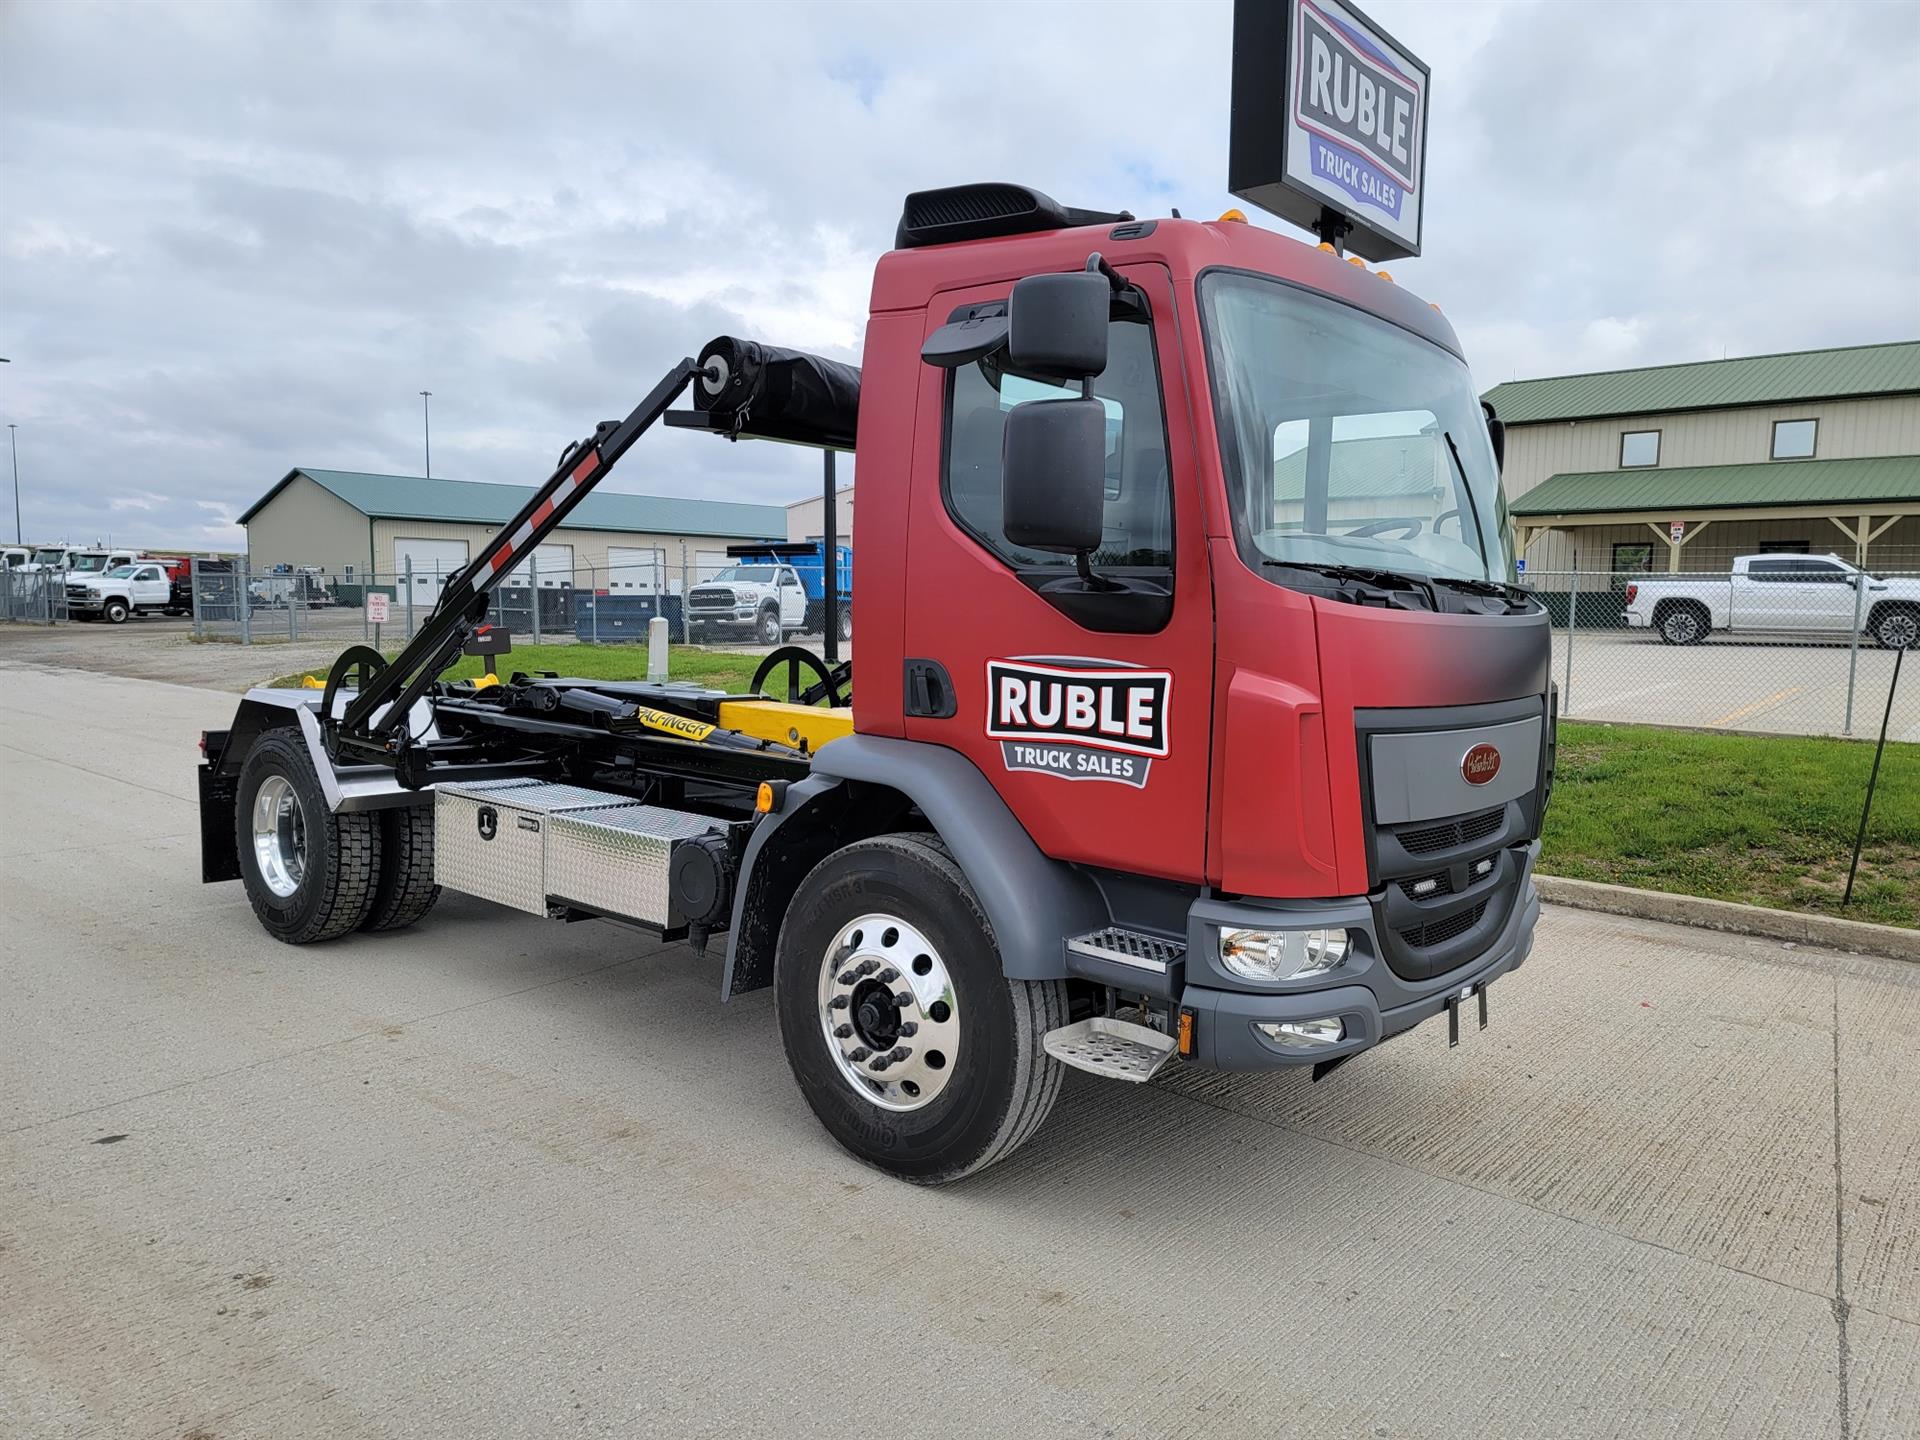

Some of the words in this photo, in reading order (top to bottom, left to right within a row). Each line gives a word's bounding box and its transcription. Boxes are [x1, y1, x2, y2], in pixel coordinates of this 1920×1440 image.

[1309, 33, 1410, 165] RUBLE
[1318, 145, 1359, 189] TRUCK
[1360, 173, 1396, 210] SALES
[1000, 676, 1155, 739] RUBLE
[1014, 746, 1072, 770] TRUCK
[1076, 753, 1134, 777] SALES
